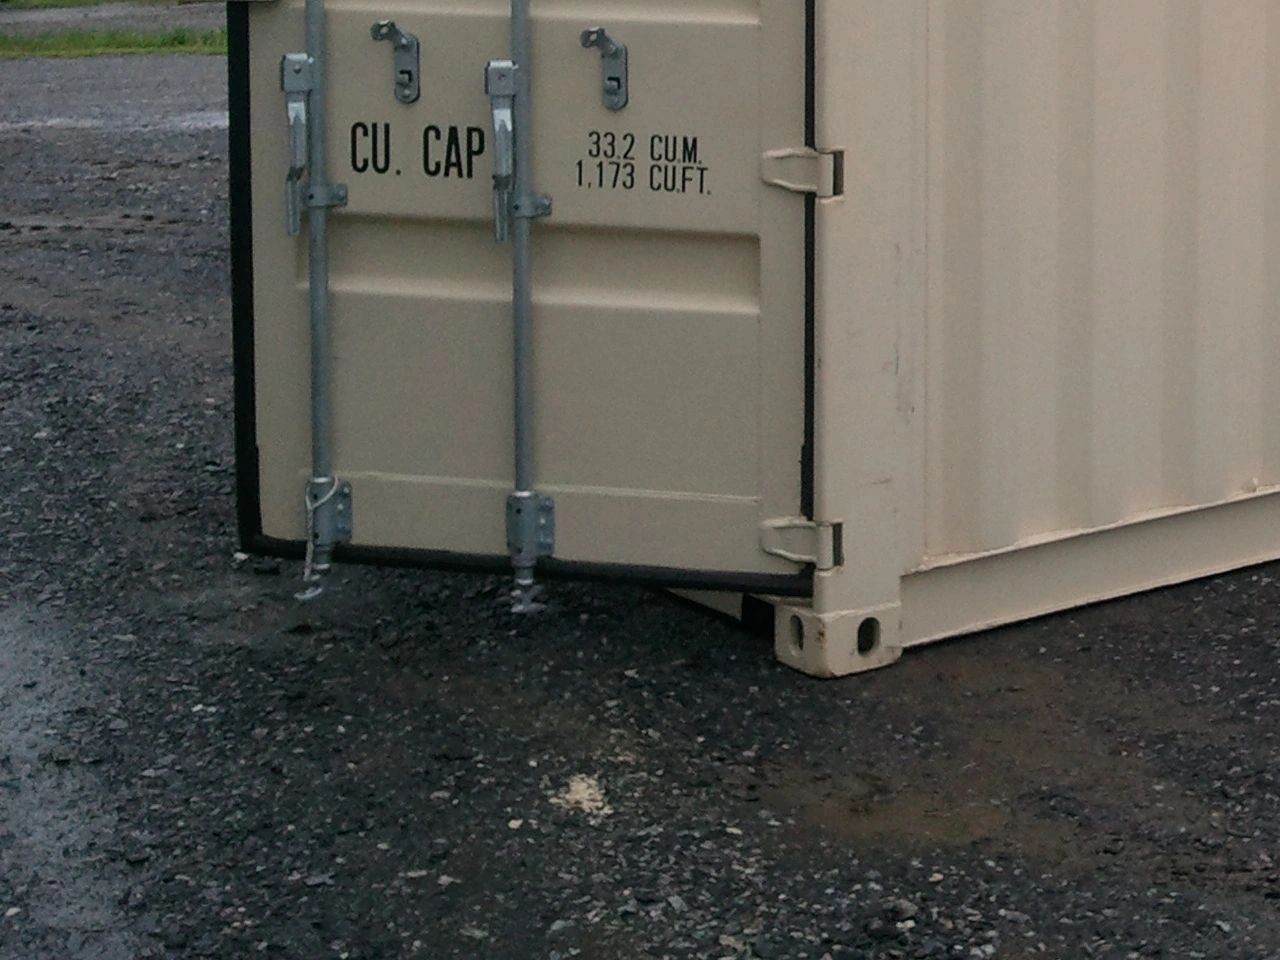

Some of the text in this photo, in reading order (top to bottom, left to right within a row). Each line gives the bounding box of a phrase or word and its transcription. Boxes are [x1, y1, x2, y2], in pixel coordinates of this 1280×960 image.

[351, 122, 485, 178] CU. CAP
[588, 131, 635, 161] 33.2
